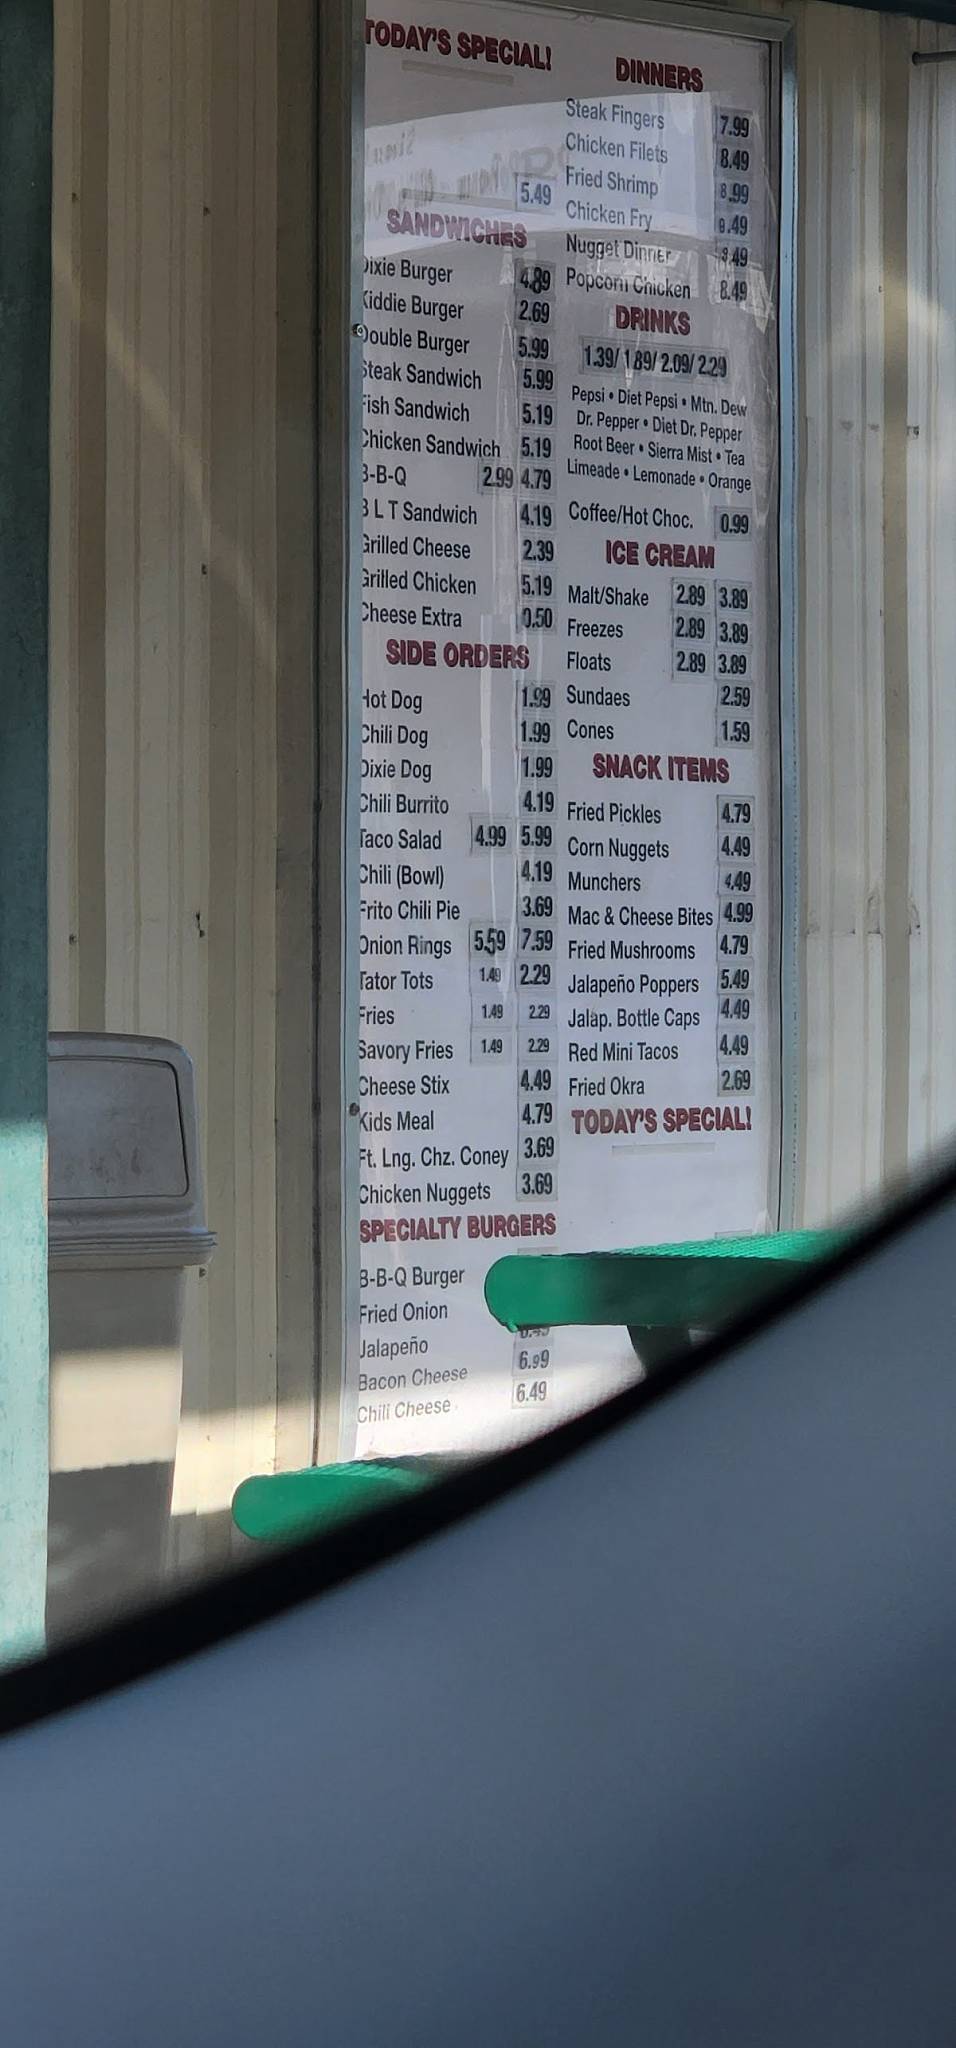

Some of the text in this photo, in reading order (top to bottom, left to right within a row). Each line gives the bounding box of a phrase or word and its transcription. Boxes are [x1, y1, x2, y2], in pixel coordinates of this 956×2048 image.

[365, 19, 551, 71] TODAY'S SPECIAL!
[616, 57, 703, 92] DINNERS
[566, 98, 749, 138] Steak Fingers 7.99
[566, 132, 749, 171] Chicken Filets 8.49
[521, 182, 551, 205] 5.49
[566, 165, 658, 199] Fried Shrimp
[386, 208, 527, 248] SANDWICHES
[566, 200, 652, 232] Chicken Fry
[567, 234, 619, 259] Nugget
[401, 259, 452, 286] Burger
[412, 295, 549, 324] Burger 2.69
[616, 304, 690, 335] DRINKS
[418, 330, 549, 359] Burger 5.99
[407, 363, 554, 391] Sandwich 5.99
[394, 397, 552, 425] Sandwich 5.19
[572, 385, 747, 417] Pepsi Diet Pepsi Mtn. Dew
[577, 410, 742, 443] Dr. Pepper Diet Dr. Pepper
[426, 434, 551, 458] Sandwich 5.19
[574, 435, 744, 465] Root Beer Sierra Mist Tea
[521, 469, 551, 490] 4.79
[568, 459, 751, 493] Limeade Lemonade Orange
[403, 501, 551, 527] Sandwich 4.19
[569, 501, 749, 534] Coffee/Hot Choc. 0.99
[413, 537, 554, 561] Cheese 2.39
[606, 540, 715, 569] ICE CREAM
[413, 571, 552, 596] Chicken 5.19
[568, 584, 748, 610] Malt/Shake 2.89 3.89
[422, 607, 462, 627] Extra
[568, 616, 748, 644] Freezes 2.89 3.89
[386, 639, 529, 669] SIDE ORDERS
[568, 651, 746, 675] Floats 2.89 3.89
[392, 690, 422, 714] Dog
[567, 684, 750, 707] Sundaes 2.59
[398, 720, 550, 748] Dog 1.99
[567, 719, 750, 742] Cones 1.59
[401, 756, 552, 783] Dog 1.99
[593, 753, 729, 783] SNACK ITEMS
[396, 790, 554, 814] Burrito 4.19
[568, 802, 750, 823] Fried Pickles 4.79
[399, 825, 552, 850] Salad 4.99 5.99
[568, 836, 750, 862] Corn Nuggets 4.49
[397, 864, 444, 889] (Bowl)
[568, 871, 640, 891] Munchers
[398, 896, 552, 920] Chili Pie 3.69
[568, 902, 753, 925] Mac & Cheese Bites 4.99
[408, 928, 553, 959] Rings 7.59
[568, 935, 748, 959] Fried Mushrooms 4.79
[401, 964, 550, 990] Tots 2.29
[568, 969, 749, 997] Jalapeño Poppers 5.49
[482, 1004, 550, 1019] 1.49 2.29
[568, 998, 749, 1031] Jalap. Bottle Caps 4.49
[416, 1038, 549, 1059] Fries 1.49 2.29
[569, 1034, 748, 1062] Red Mini Tacos 4.49
[421, 1069, 551, 1095] Stix 4.49
[569, 1070, 750, 1096] Fried Okra 2.69
[397, 1103, 552, 1130] Meal 4.79
[571, 1106, 751, 1134] TODAY'S SPECIAL!
[383, 1136, 554, 1171] Lng. Chz. Coney 3.69
[427, 1173, 552, 1206] Nuggets 3.69
[360, 1213, 556, 1243] SPECIALTY BURGERS
[413, 1267, 464, 1289] Burger
[403, 1302, 448, 1322] Onion
[359, 1349, 549, 1391] Bacon Cheese 6.99
[358, 1381, 547, 1423] Chili Cheese 6.49
